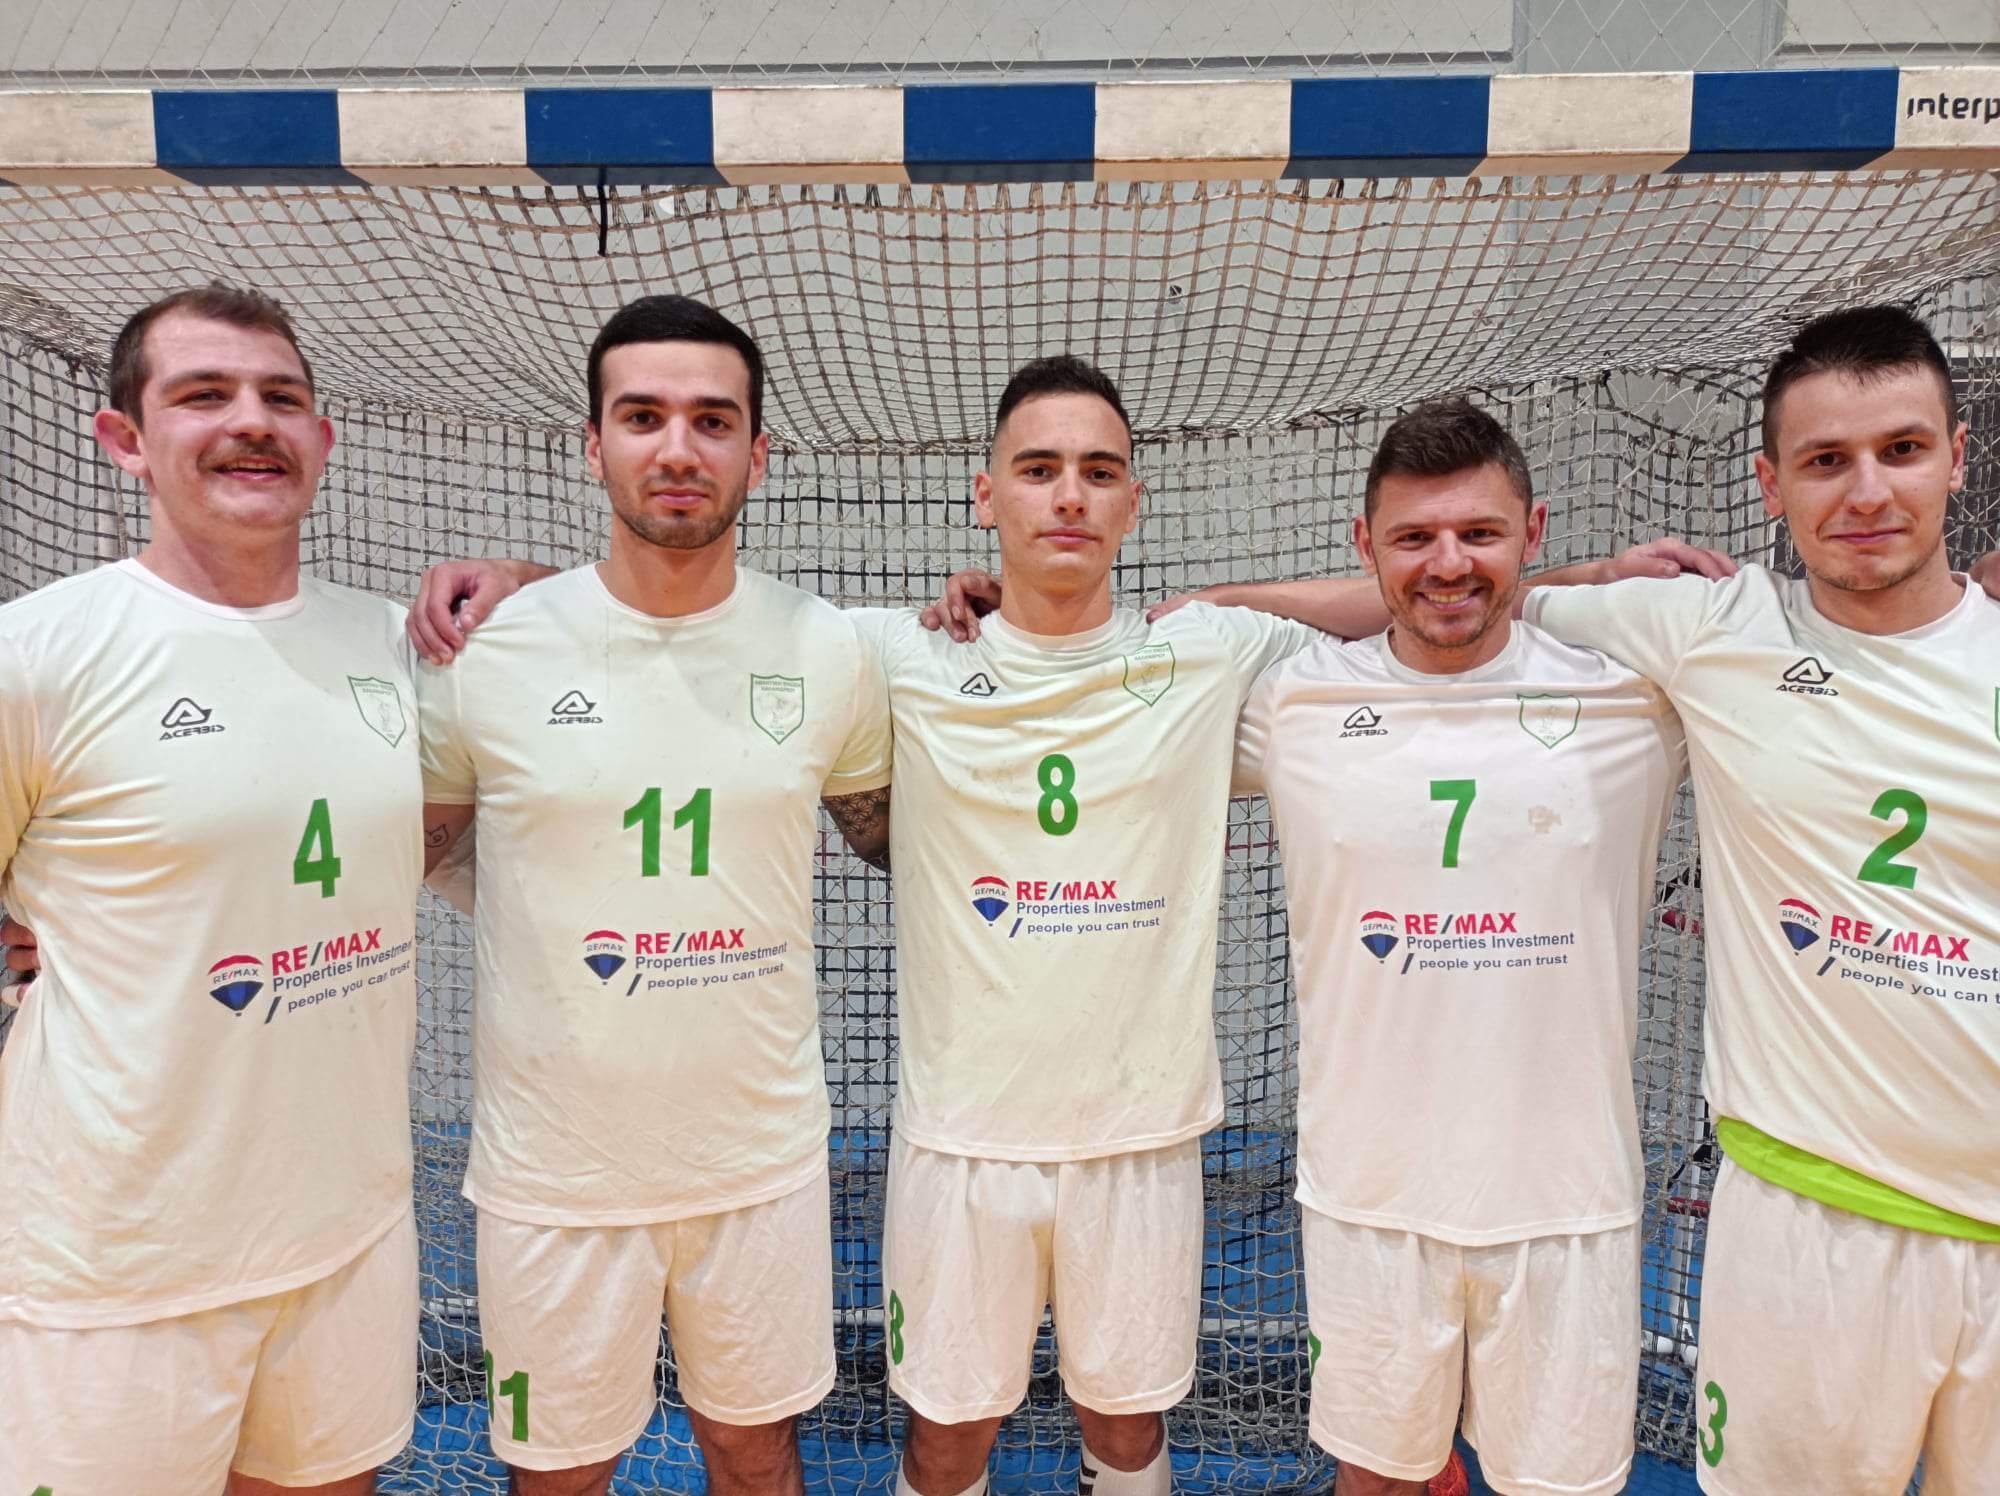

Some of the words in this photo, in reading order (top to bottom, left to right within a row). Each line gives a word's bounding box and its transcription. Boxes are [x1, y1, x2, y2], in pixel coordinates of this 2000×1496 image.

[1776, 683, 1839, 696] ACERBIS
[159, 724, 226, 741] ACERBIS
[547, 716, 603, 725] ACERBIS
[1339, 729, 1389, 738] ACERBIS
[1037, 753, 1079, 837] 8
[623, 787, 712, 877] 11
[1429, 778, 1477, 868] 7
[293, 798, 341, 898] 4
[1856, 788, 1928, 890] 2
[974, 887, 1007, 897] RE/MAX
[1016, 880, 1117, 901] RE/MAX
[1016, 901, 1090, 918] Properties
[1094, 896, 1166, 914] Investment
[1781, 909, 1820, 929] RE/MAX
[1027, 922, 1073, 934] people
[1077, 923, 1102, 934] you
[1106, 920, 1129, 931] can
[1132, 917, 1160, 929] trust
[1362, 923, 1396, 933] RE/MAX
[1404, 912, 1518, 935] RE/MAX
[586, 943, 624, 954] RE/MAX
[635, 928, 746, 955] RE/MAX
[1406, 936, 1487, 952] Properties
[1492, 932, 1575, 949] Investment
[1830, 914, 1970, 962] RE/MAX
[271, 927, 382, 977] RE/MAX
[272, 961, 354, 993] Properties
[356, 936, 413, 970] Investme
[635, 954, 716, 972] Properties
[720, 940, 788, 964] Investment
[1419, 958, 1470, 971] people
[1473, 960, 1502, 971] you
[1506, 957, 1532, 968] can
[1536, 954, 1568, 966] trust
[1828, 938, 1929, 974] Properties
[1936, 960, 2000, 982] Invest
[213, 967, 260, 985] RE/MAX
[647, 976, 698, 991] people
[702, 973, 729, 987] you
[732, 970, 756, 982] can
[758, 963, 785, 978] trust
[1841, 967, 1905, 990] people
[1911, 983, 1947, 997] you
[1954, 990, 1988, 1003] can
[287, 987, 338, 1013] people
[342, 979, 363, 999] you
[889, 1289, 905, 1365] 8
[1698, 1381, 1728, 1468] 3
